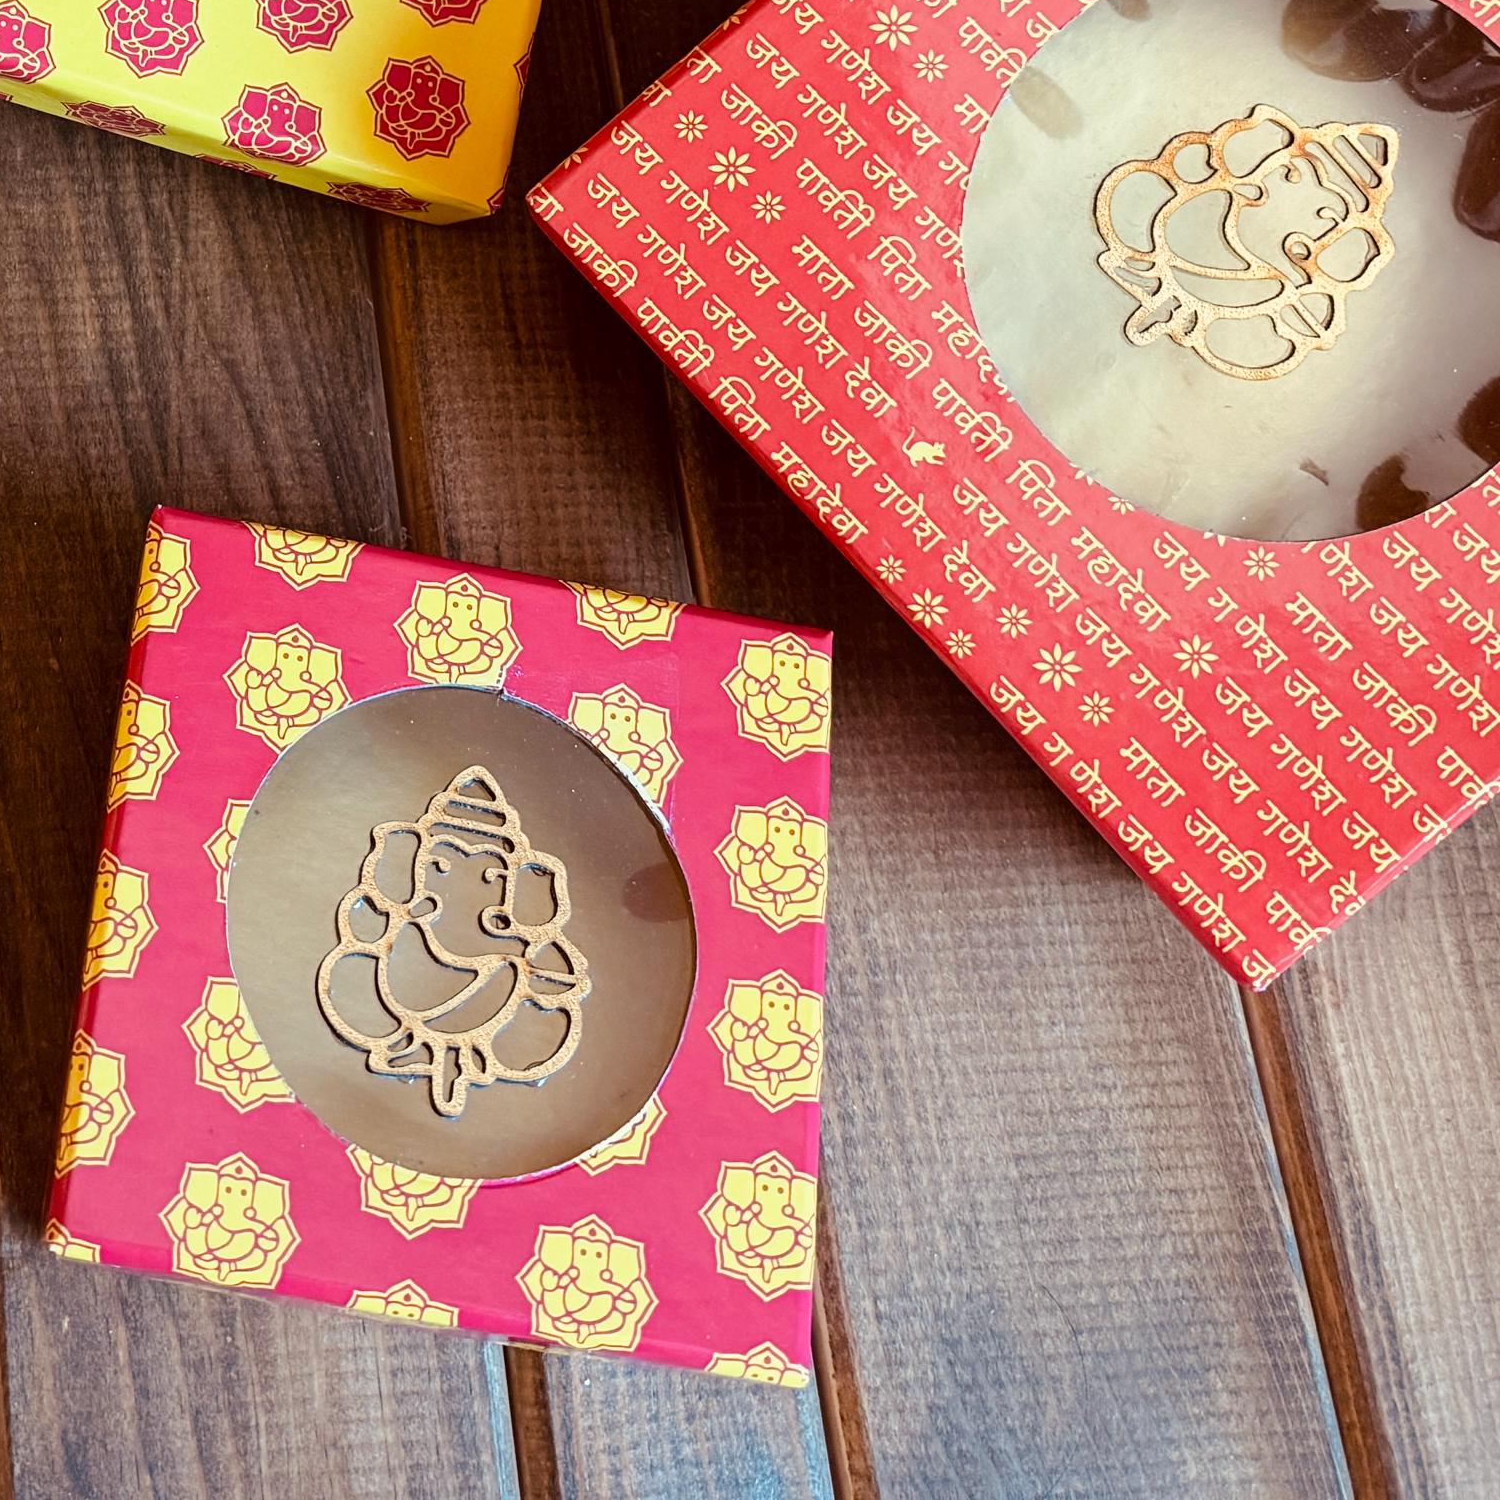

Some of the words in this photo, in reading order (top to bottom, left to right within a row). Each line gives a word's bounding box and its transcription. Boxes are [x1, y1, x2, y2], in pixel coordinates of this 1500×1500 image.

[720, 82, 799, 161] जाकी
[795, 157, 876, 240] पार्वती
[867, 235, 933, 301] पिता
[745, 32, 801, 90] जय
[796, 83, 868, 160] गणेश
[862, 153, 919, 211] जय
[820, 29, 892, 106] गणेश
[886, 98, 943, 156] जय
[562, 221, 639, 298] जाकी
[636, 296, 716, 379] पार्वती
[708, 375, 772, 442] पिता
[770, 440, 869, 545] महादेवा
[989, 675, 1048, 736] जय
[1117, 813, 1176, 875] जय
[1171, 870, 1247, 953] गणेश
[586, 172, 641, 229] जय
[636, 223, 707, 301] गणेश
[702, 293, 757, 352] जय
[753, 346, 826, 425] गणेश
[820, 418, 878, 478] जय
[873, 472, 947, 553] गणेश
[942, 539, 997, 604] देवा
[1119, 736, 1187, 808] माता
[1184, 807, 1268, 893] जाकी
[610, 119, 664, 176] जय
[659, 169, 731, 246] गणेश
[725, 239, 781, 297] जय
[776, 291, 850, 370] गणेश
[844, 355, 898, 419] देवा
[952, 477, 1010, 538] जय
[1006, 531, 1080, 613] गणेश
[1075, 607, 1133, 669] जय
[1201, 741, 1261, 805] जय
[1256, 799, 1334, 884] गणेश
[791, 234, 855, 301] माता
[853, 300, 933, 380] जाकी
[940, 377, 1013, 463] पार्वती
[1005, 459, 1073, 526] पिता
[1070, 526, 1172, 633] महादेवा
[1215, 675, 1274, 739] जय
[1269, 733, 1348, 817] गणेश
[1341, 810, 1402, 873] जय
[1382, 530, 1443, 592] जय
[1153, 531, 1211, 592] जय
[1283, 668, 1344, 731] जय
[1339, 725, 1418, 810] गणेश
[1285, 591, 1354, 662] माता
[1352, 661, 1438, 748] जाकी
[1369, 596, 1430, 659] जय
